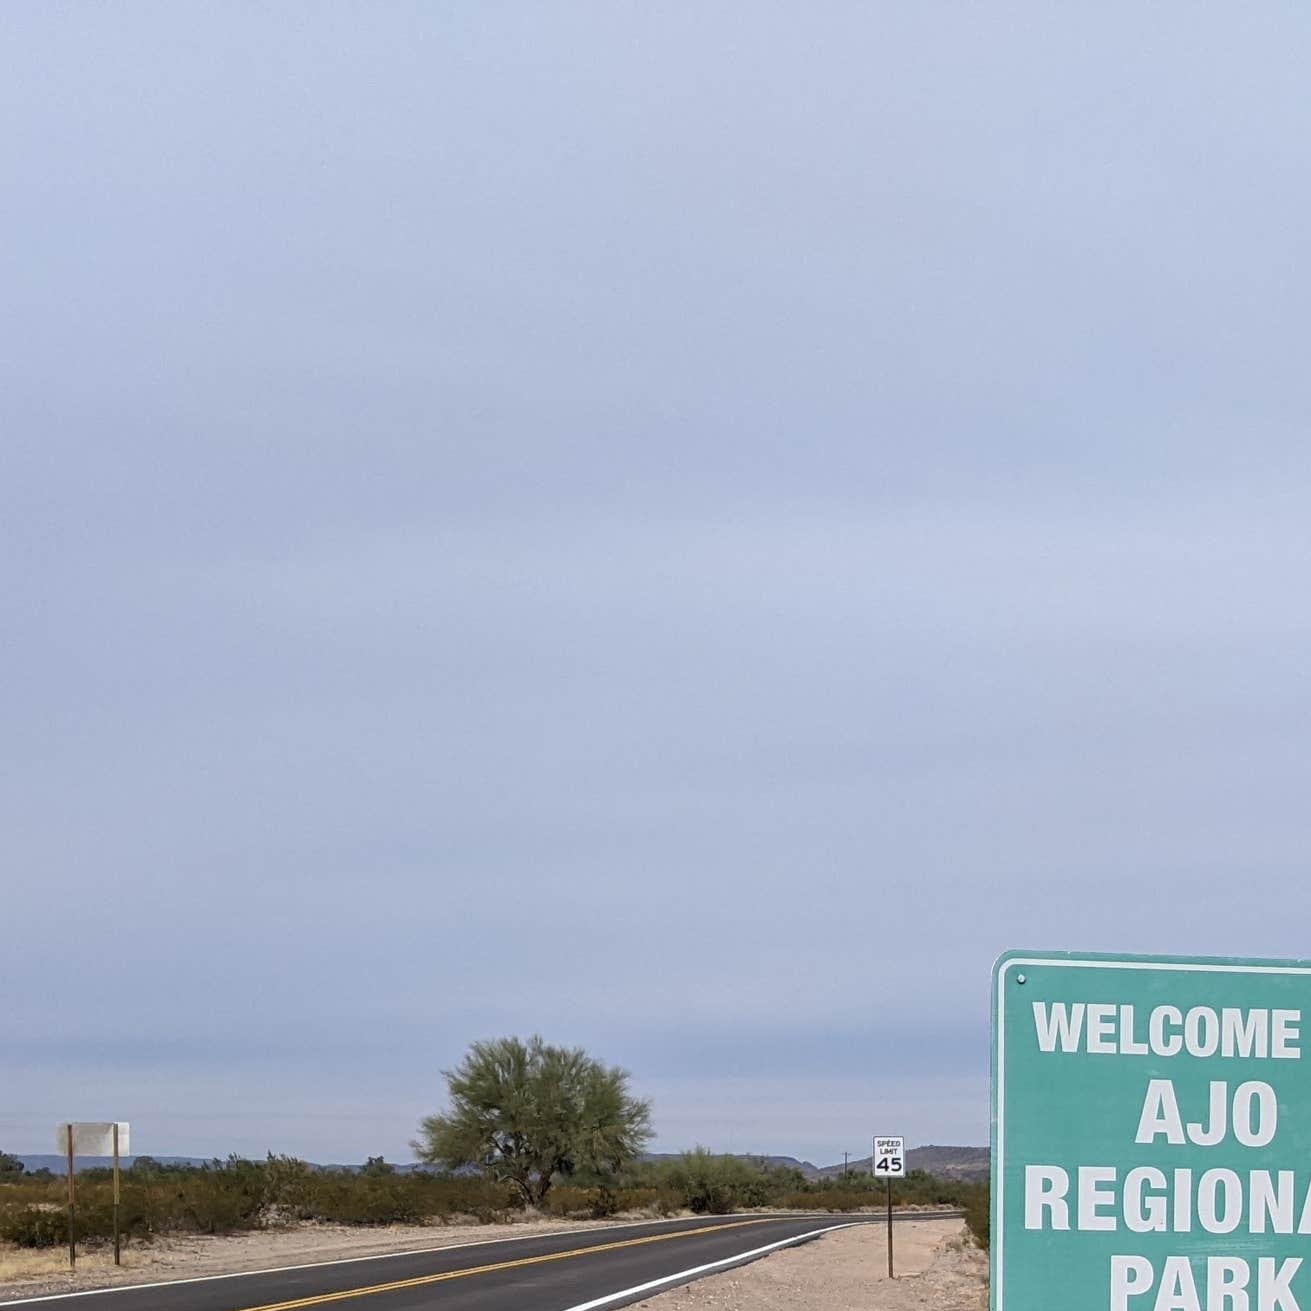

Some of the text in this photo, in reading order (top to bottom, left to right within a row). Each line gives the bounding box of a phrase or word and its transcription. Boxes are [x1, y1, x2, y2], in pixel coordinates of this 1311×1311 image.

[1032, 1001, 1301, 1059] WELCOME
[1134, 1079, 1277, 1147] AJO
[876, 1157, 902, 1172] 45
